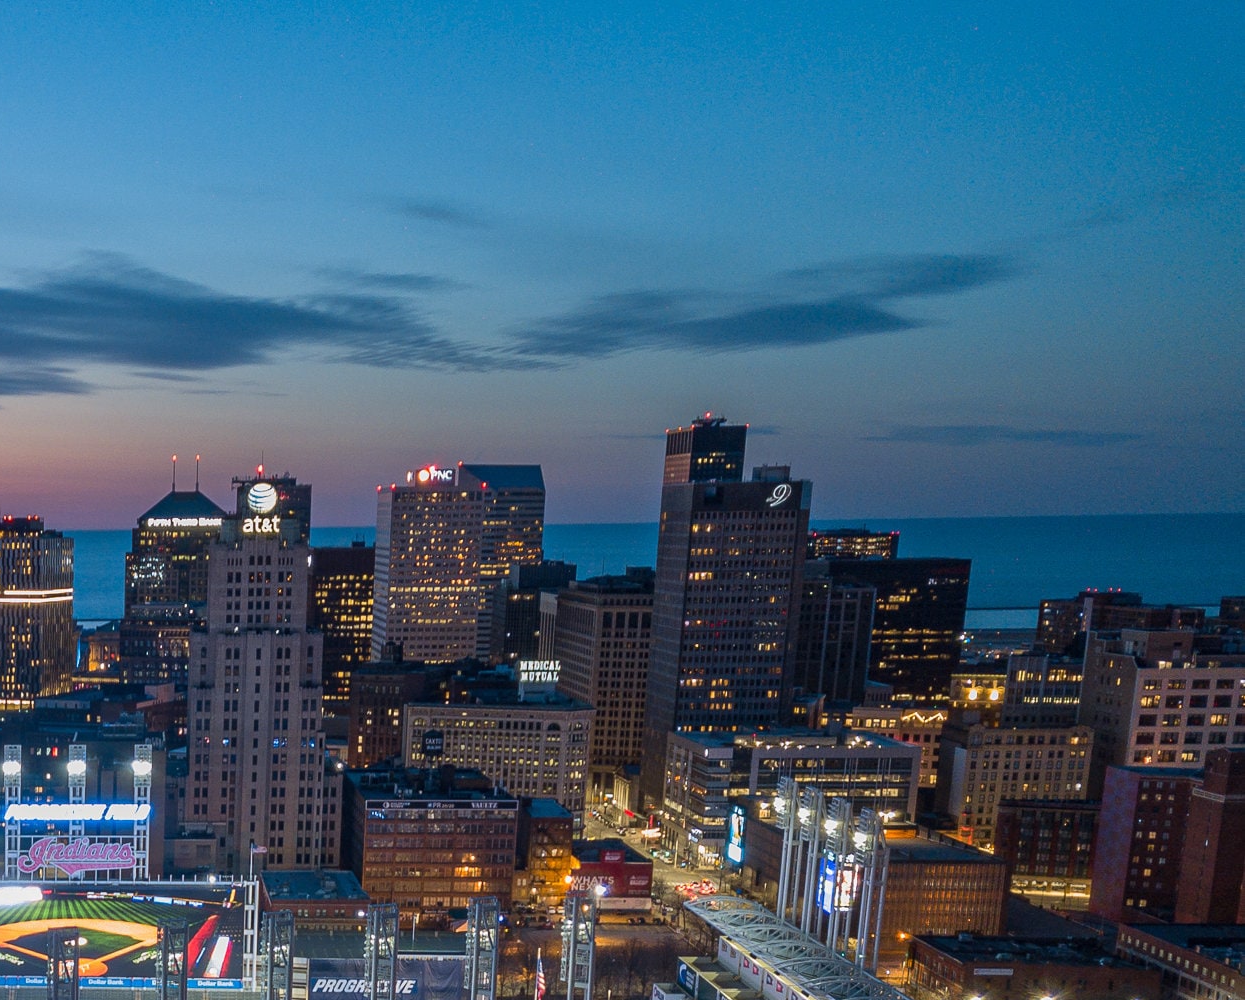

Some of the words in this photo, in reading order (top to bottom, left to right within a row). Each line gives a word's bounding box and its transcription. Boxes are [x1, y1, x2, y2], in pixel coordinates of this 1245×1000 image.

[430, 469, 453, 481] PNC
[242, 515, 281, 533] at&t
[520, 660, 561, 671] MEDICAL
[520, 671, 559, 682] MUTUAL
[17, 837, 136, 875] Indians
[572, 875, 614, 884] WHAT'S
[571, 883, 597, 891] NEX
[197, 979, 215, 987] Dollar
